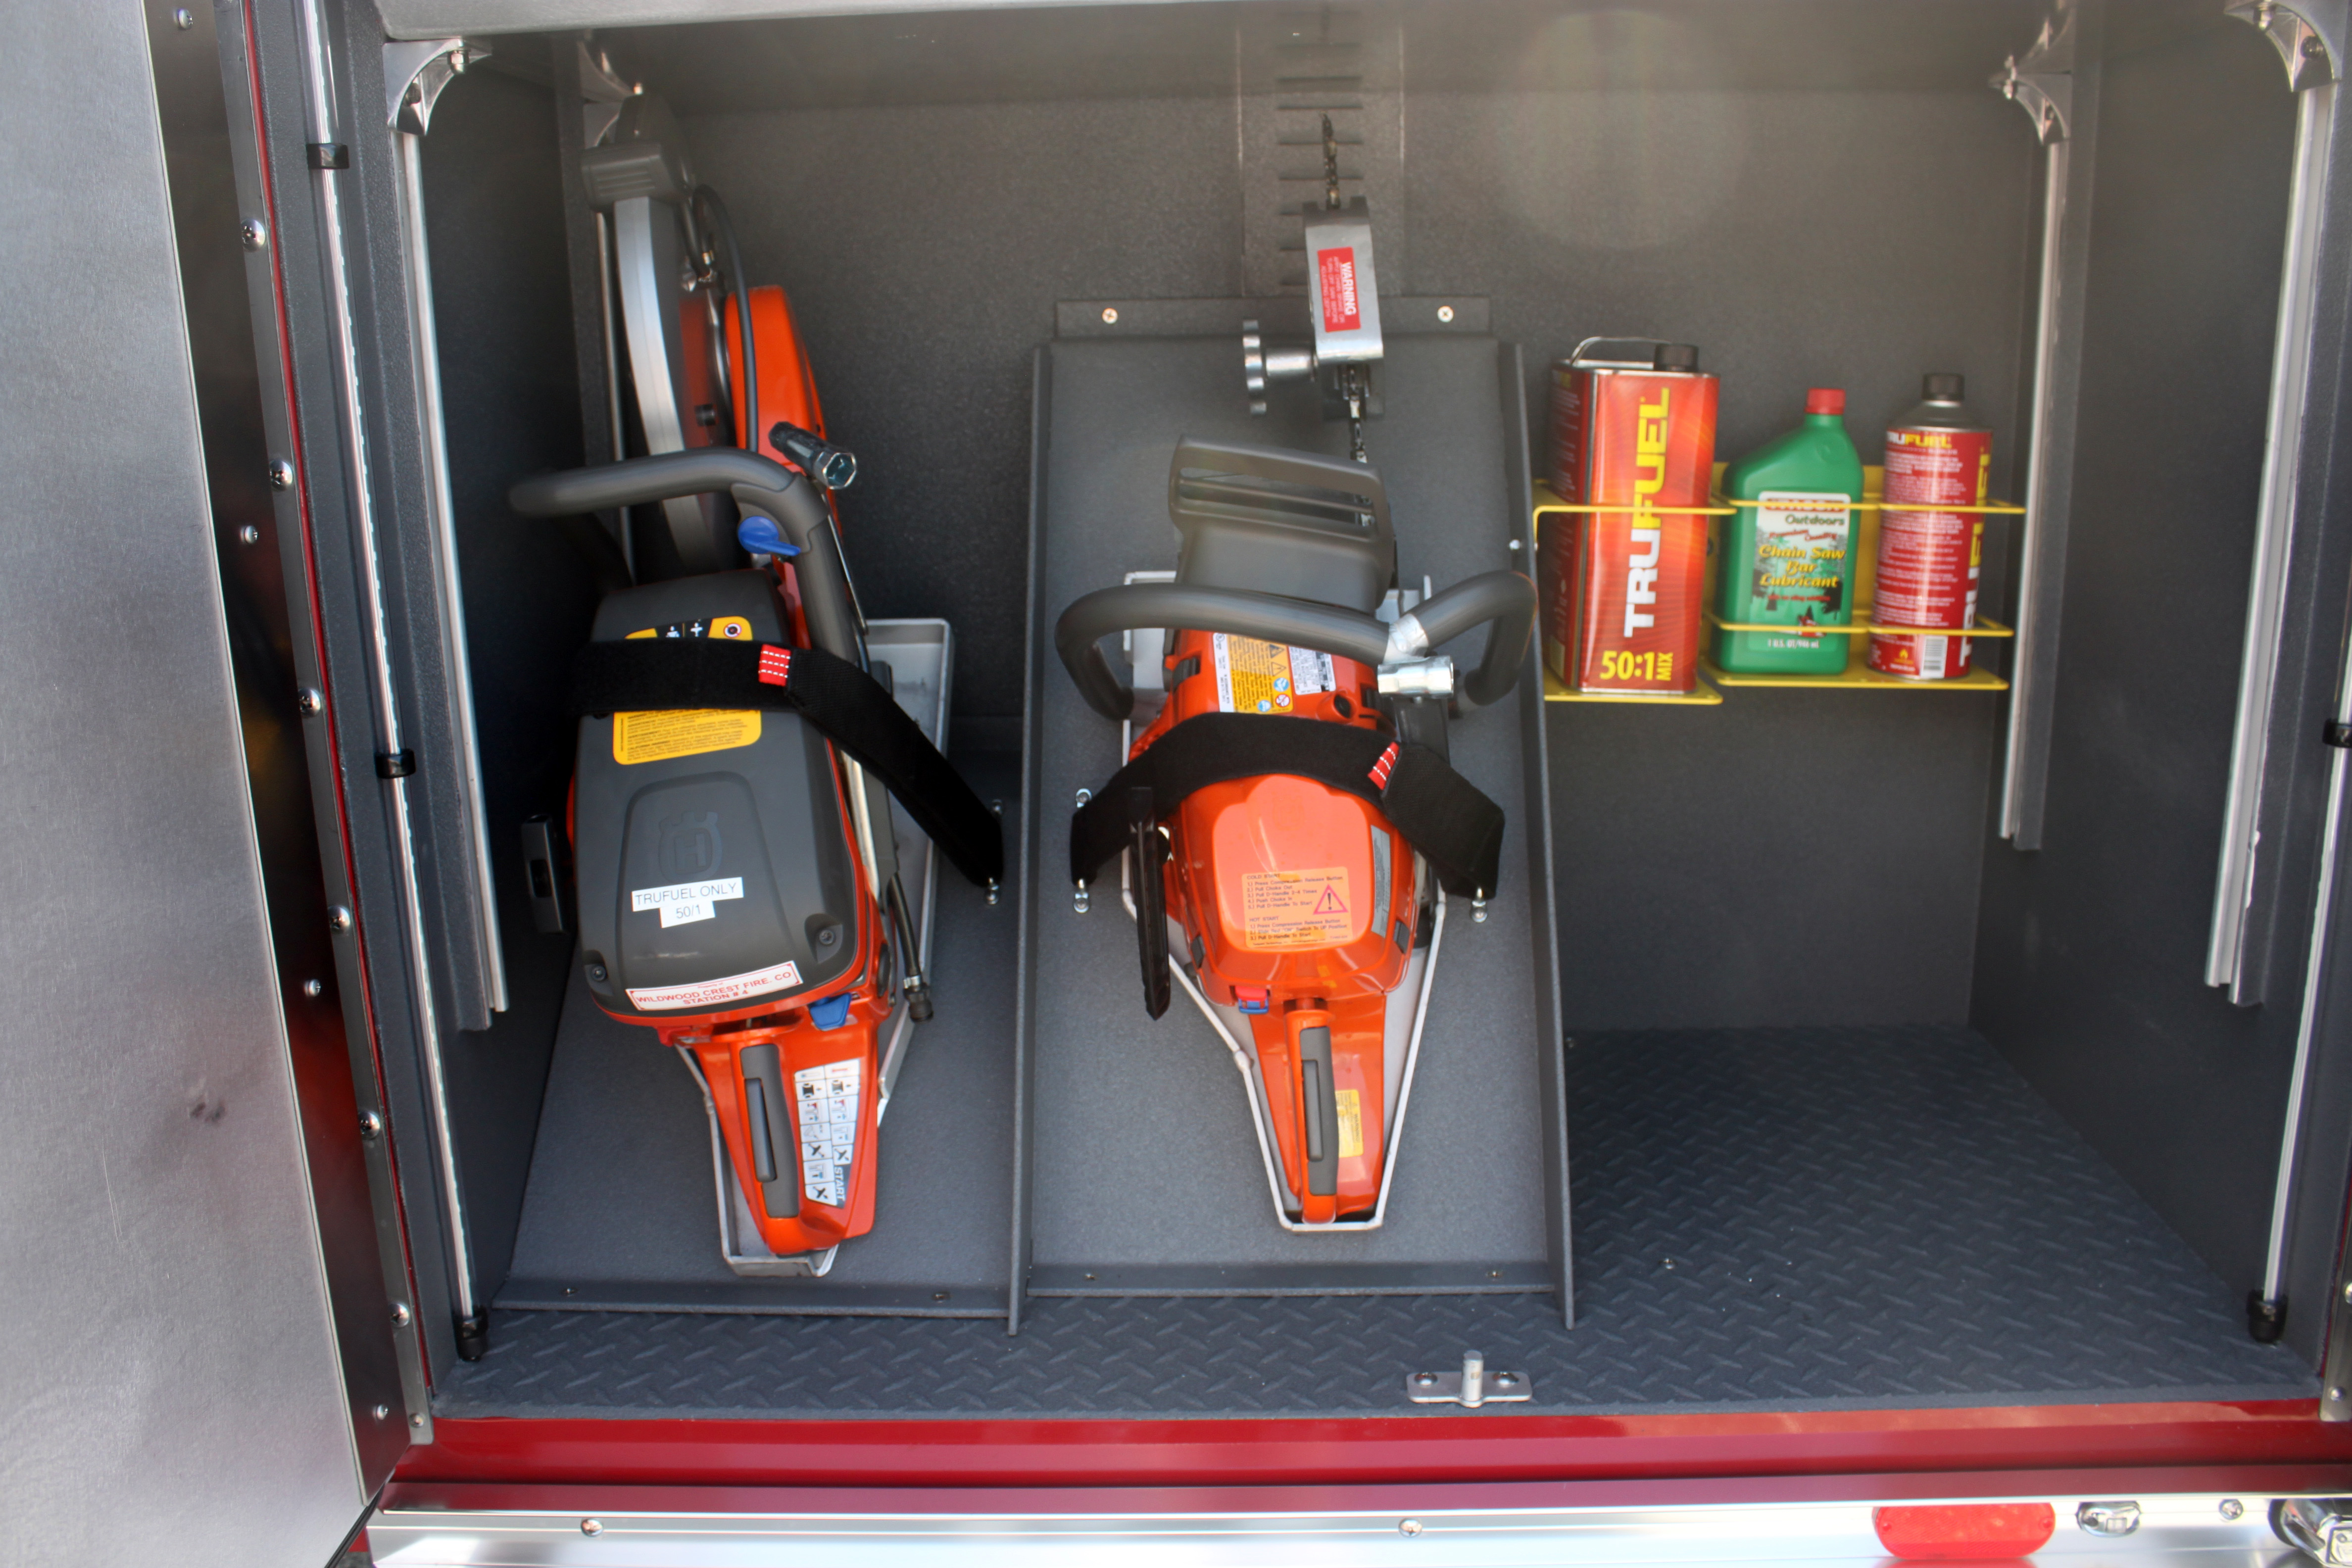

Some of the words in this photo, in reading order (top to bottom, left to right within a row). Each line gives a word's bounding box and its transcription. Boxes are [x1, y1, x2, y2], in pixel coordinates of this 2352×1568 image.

[1341, 262, 1357, 315] WARNING
[1623, 388, 1669, 638] TRUFUEL
[1785, 514, 1845, 526] Outdoors
[1759, 544, 1807, 559] Chain
[1810, 546, 1846, 560] Saw
[1785, 559, 1817, 576] Bar
[1759, 573, 1840, 588] Lubricant
[1600, 650, 1654, 681] 50:1
[1656, 651, 1673, 681] MIX
[635, 887, 696, 905] TRUFUEL
[699, 882, 736, 897] ONLY
[676, 904, 701, 919] 50/1
[636, 991, 700, 1003] WILDWOOD
[702, 984, 740, 997] CREST
[775, 972, 791, 981] CO
[683, 993, 731, 1005] STATION
[834, 1167, 846, 1202] START
